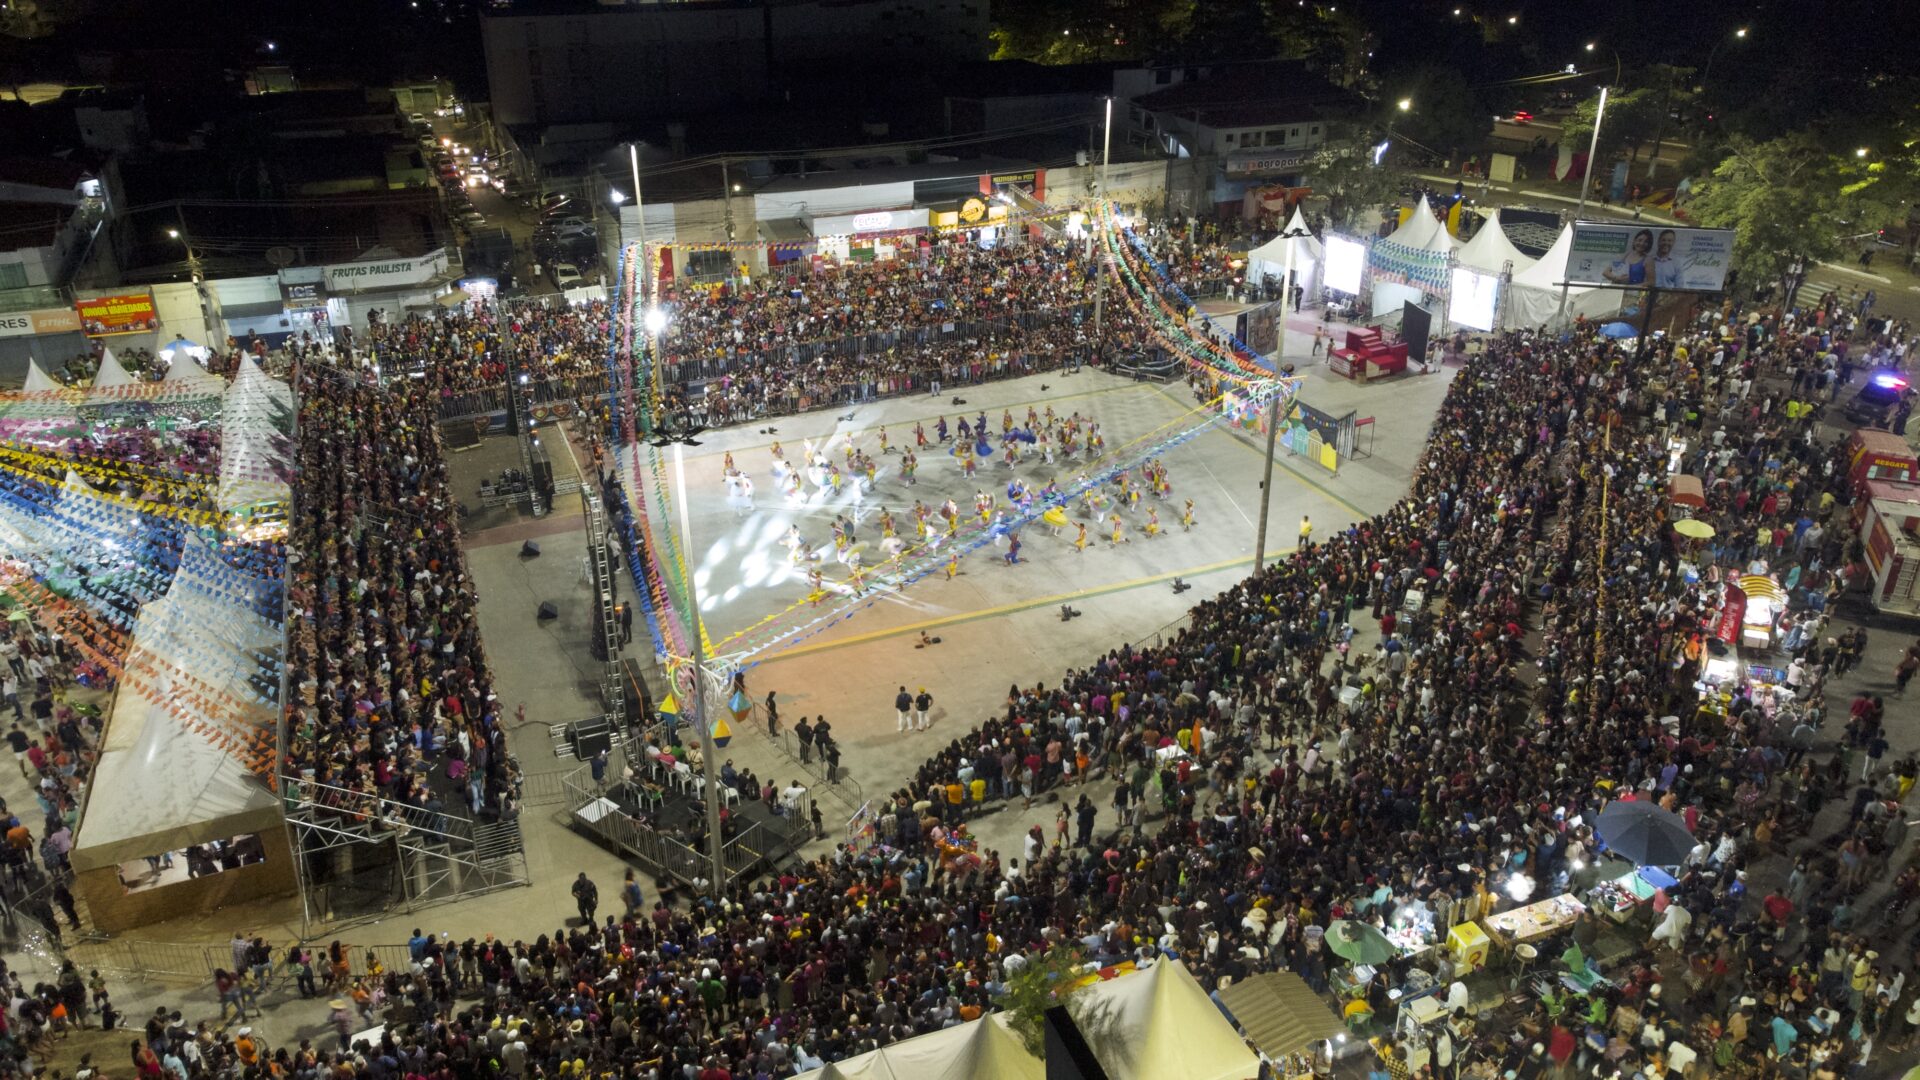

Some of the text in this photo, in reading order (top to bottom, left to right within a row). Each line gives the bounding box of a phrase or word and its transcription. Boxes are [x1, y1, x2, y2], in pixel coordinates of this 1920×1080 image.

[332, 262, 411, 278] FRUTAS PAULISTA
[0, 318, 28, 329] RES
[1875, 459, 1909, 469] RESGATE
